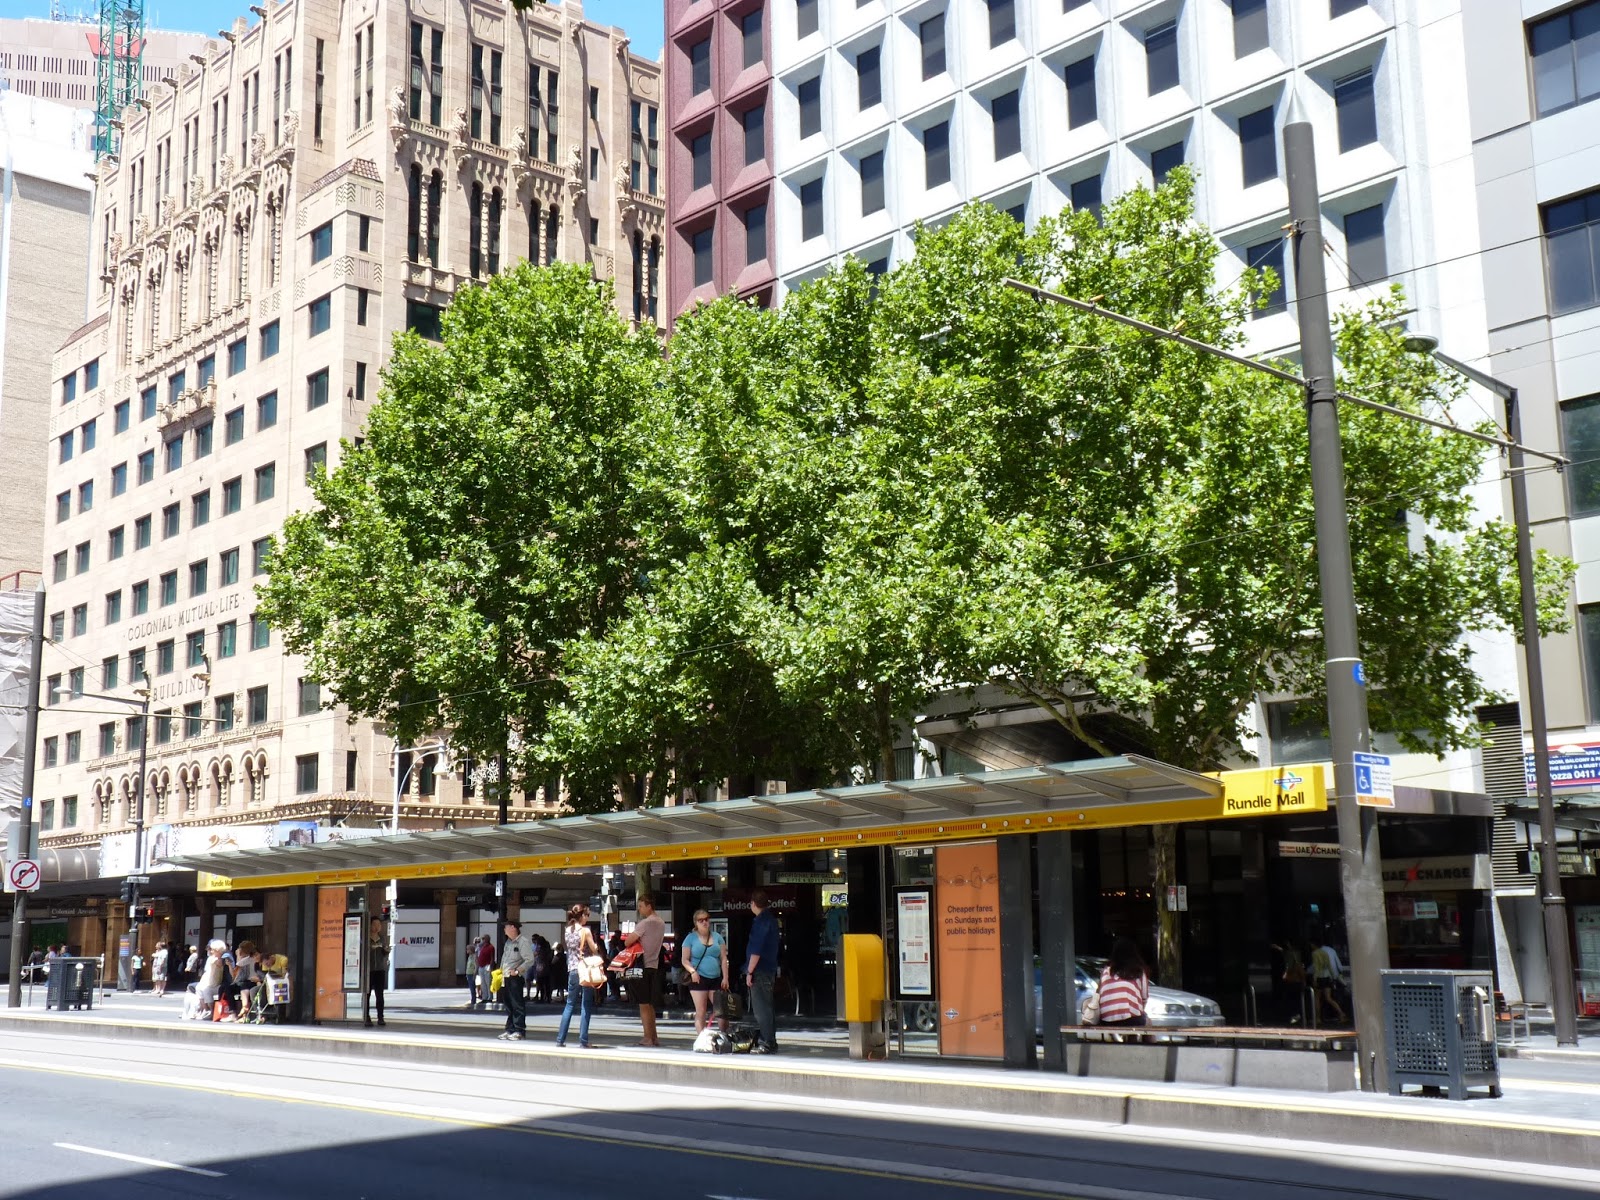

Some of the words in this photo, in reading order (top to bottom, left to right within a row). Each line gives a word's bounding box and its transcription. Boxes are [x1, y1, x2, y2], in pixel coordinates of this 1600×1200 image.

[127, 615, 173, 641] COLONIAL
[178, 602, 215, 627] MUTUAL
[219, 593, 240, 613] LIFE
[153, 678, 204, 702] BUILDING
[1574, 770, 1596, 778] 0411
[1227, 795, 1271, 810] Rundle
[1277, 792, 1305, 806] Mall
[723, 901, 752, 910] Hudso
[947, 905, 975, 913] Cheaper
[954, 916, 982, 924] Sundays
[968, 927, 995, 935] holidays
[410, 936, 435, 944] WATPAC
